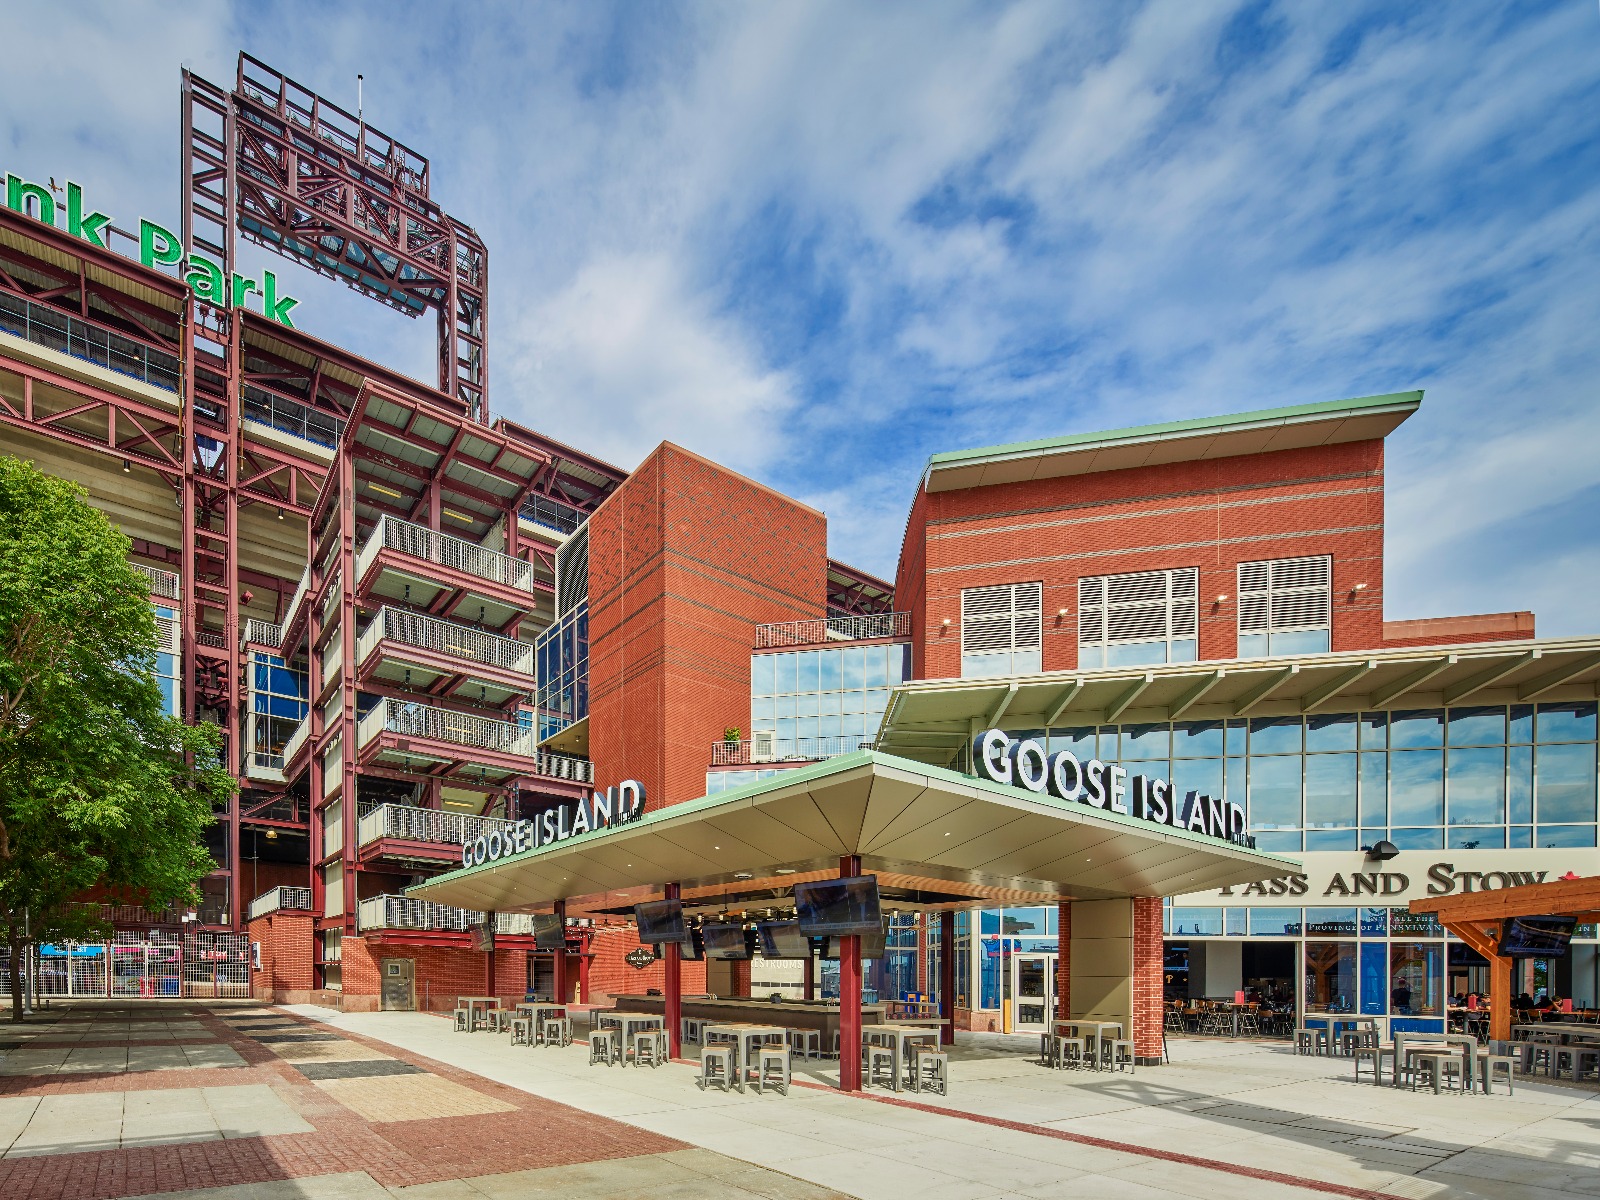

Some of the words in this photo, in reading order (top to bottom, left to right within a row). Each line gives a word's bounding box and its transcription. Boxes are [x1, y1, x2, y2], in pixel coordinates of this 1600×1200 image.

[138, 215, 302, 328] Park
[462, 820, 530, 869] GOOSE
[535, 779, 645, 848] ISLAND
[974, 728, 1127, 815] GOOSE
[1134, 774, 1247, 839] ISLAND
[1219, 873, 1309, 894] ASS
[1323, 872, 1410, 894] AND
[1428, 862, 1549, 894] STOW
